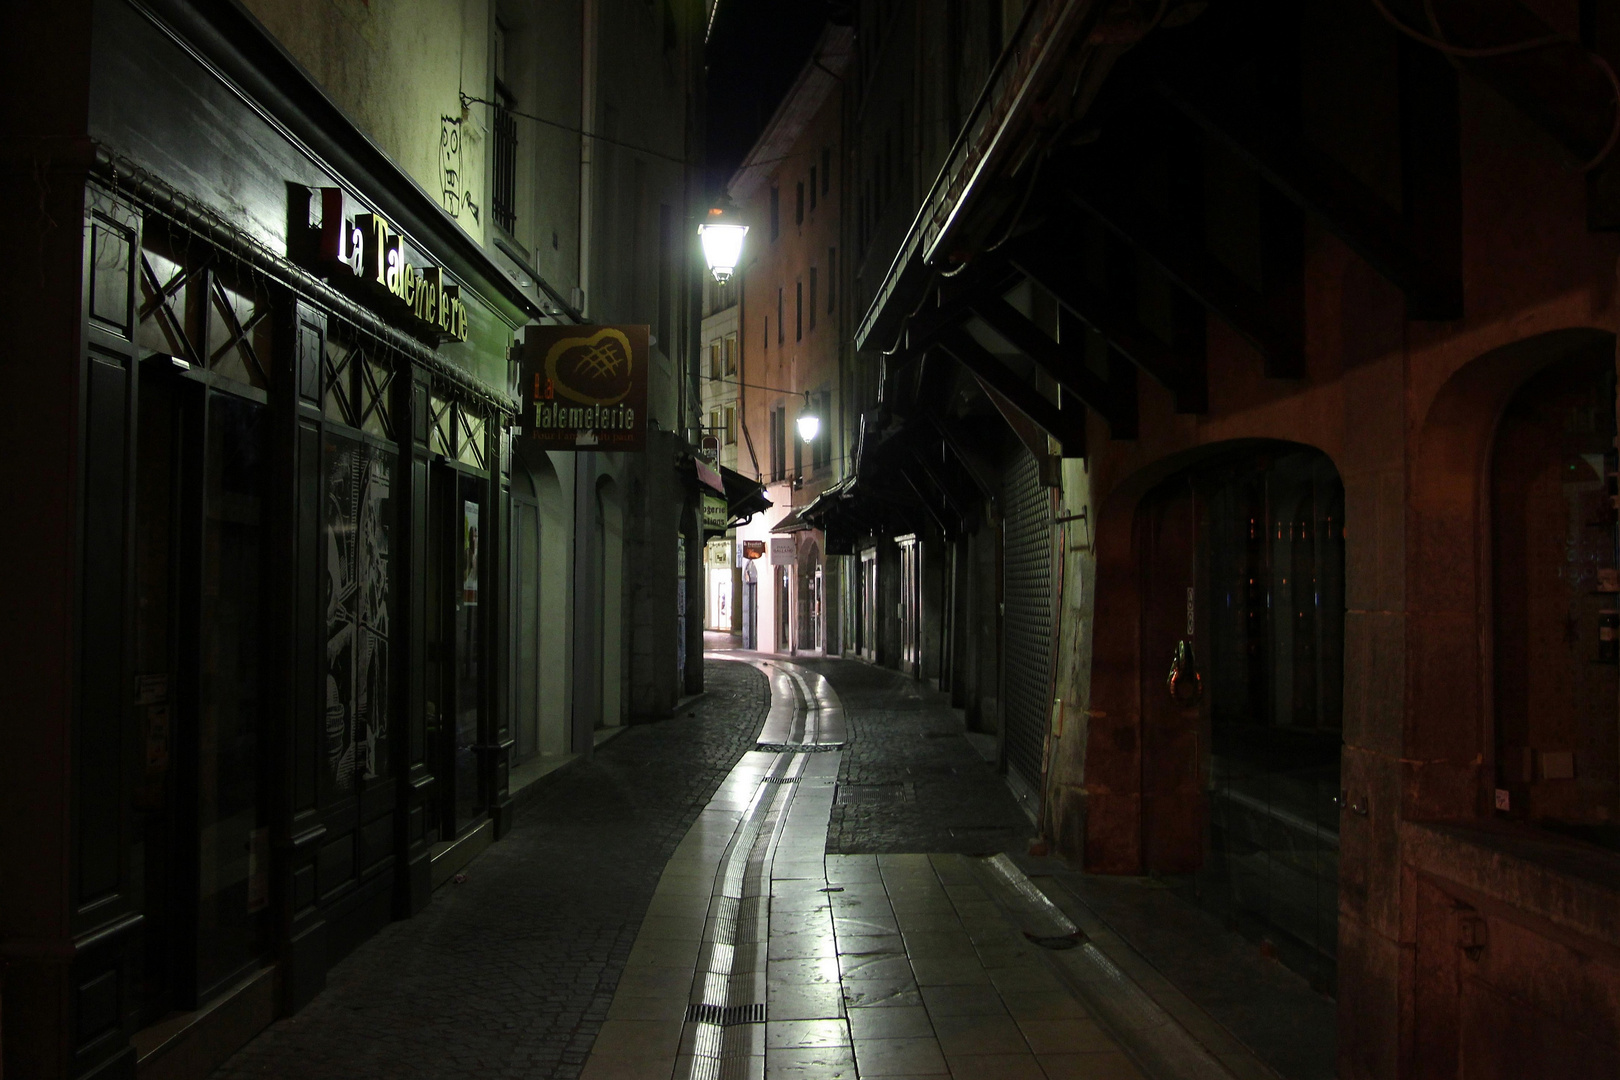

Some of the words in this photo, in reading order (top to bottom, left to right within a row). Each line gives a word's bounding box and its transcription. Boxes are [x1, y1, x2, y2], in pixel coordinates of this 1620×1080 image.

[337, 190, 364, 278] La
[372, 213, 468, 343] Talemelerie
[534, 373, 554, 399] La
[533, 402, 634, 429] Talemelerie
